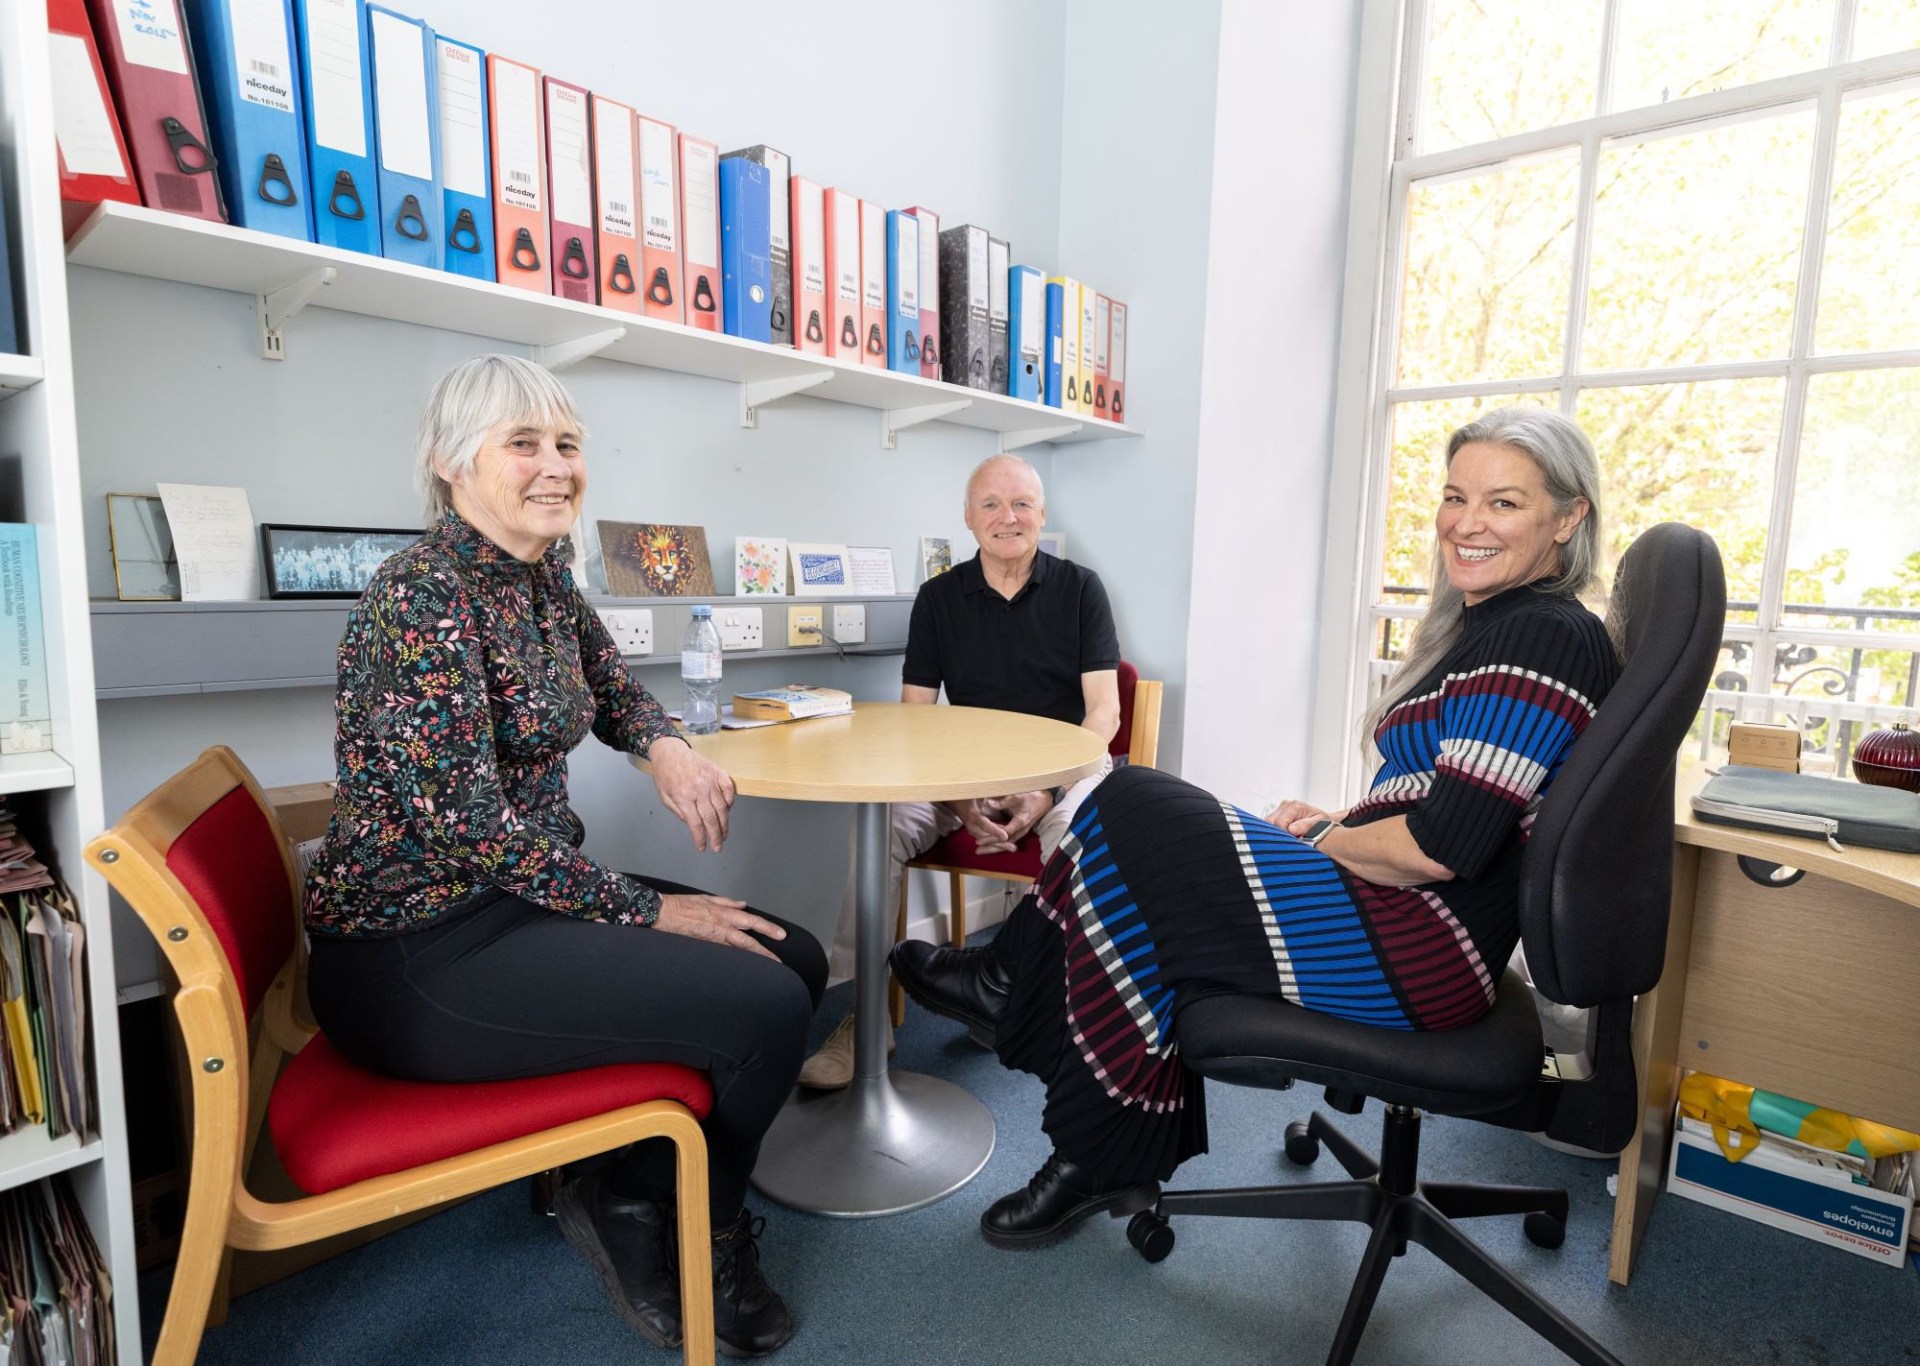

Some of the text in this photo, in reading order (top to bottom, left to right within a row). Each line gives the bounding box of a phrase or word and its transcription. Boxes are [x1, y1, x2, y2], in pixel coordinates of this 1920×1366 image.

[246, 78, 287, 97] niceday
[505, 185, 536, 199] niceday
[605, 215, 631, 227] niceday
[647, 229, 672, 241] niceday
[4, 574, 12, 588] with
[11, 540, 30, 667] HUMAN COGNITIVE NEUROPSYCHOLOGY
[1823, 1210, 1894, 1238] envelopes
[1857, 1241, 1891, 1256] Office
